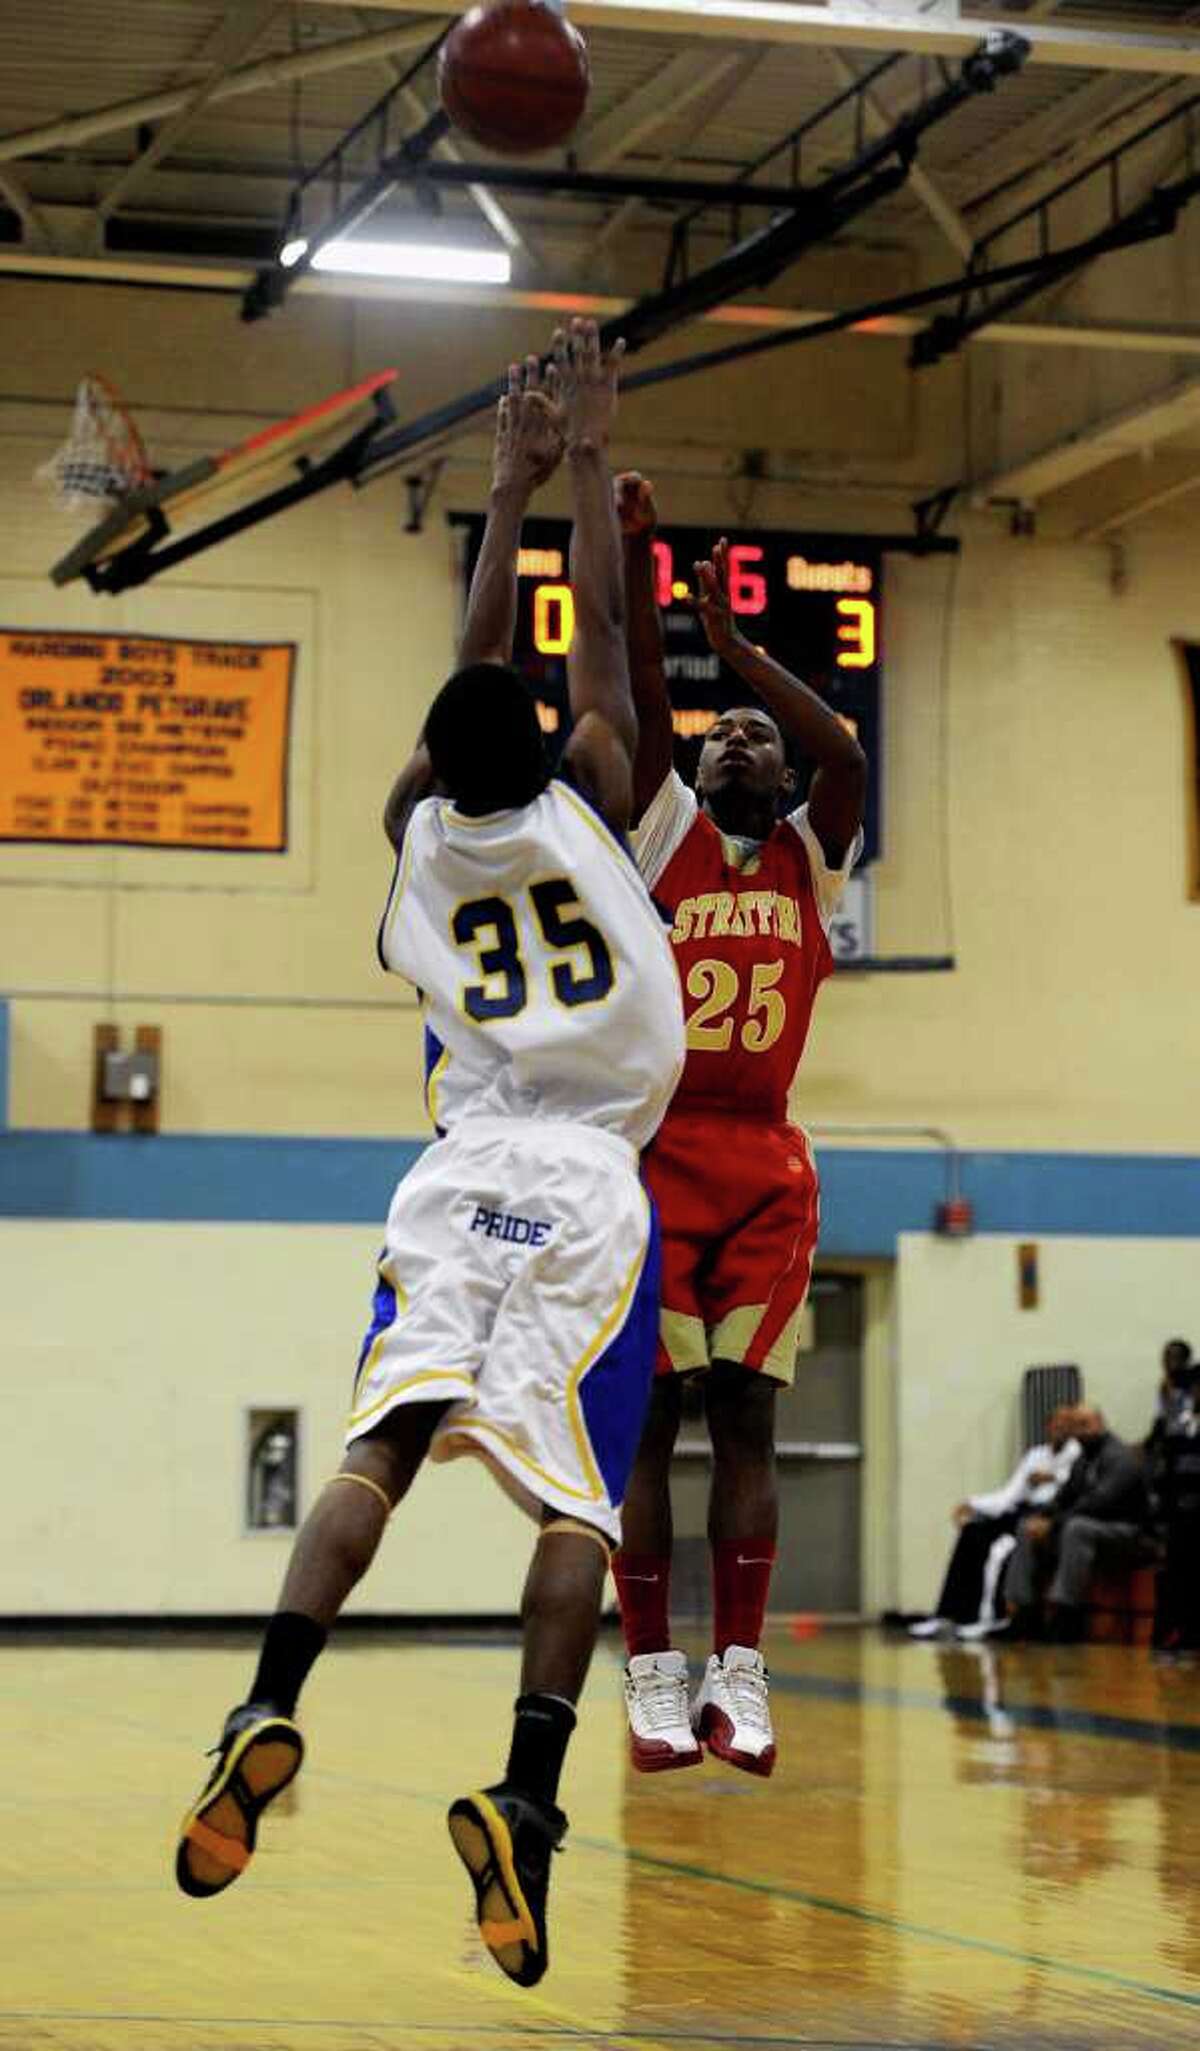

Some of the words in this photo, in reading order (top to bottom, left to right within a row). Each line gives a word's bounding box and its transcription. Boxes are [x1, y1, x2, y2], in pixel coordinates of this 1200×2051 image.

[534, 584, 575, 655] 0
[837, 599, 875, 668] 3
[9, 639, 105, 660] HARDING
[118, 643, 176, 663] BOYS
[192, 649, 262, 669] TRACK
[101, 666, 176, 687] 2003
[19, 687, 124, 712] ORLANDO
[450, 873, 618, 1025] 35
[685, 958, 786, 1053] 25
[470, 1205, 552, 1246] PRIDE
